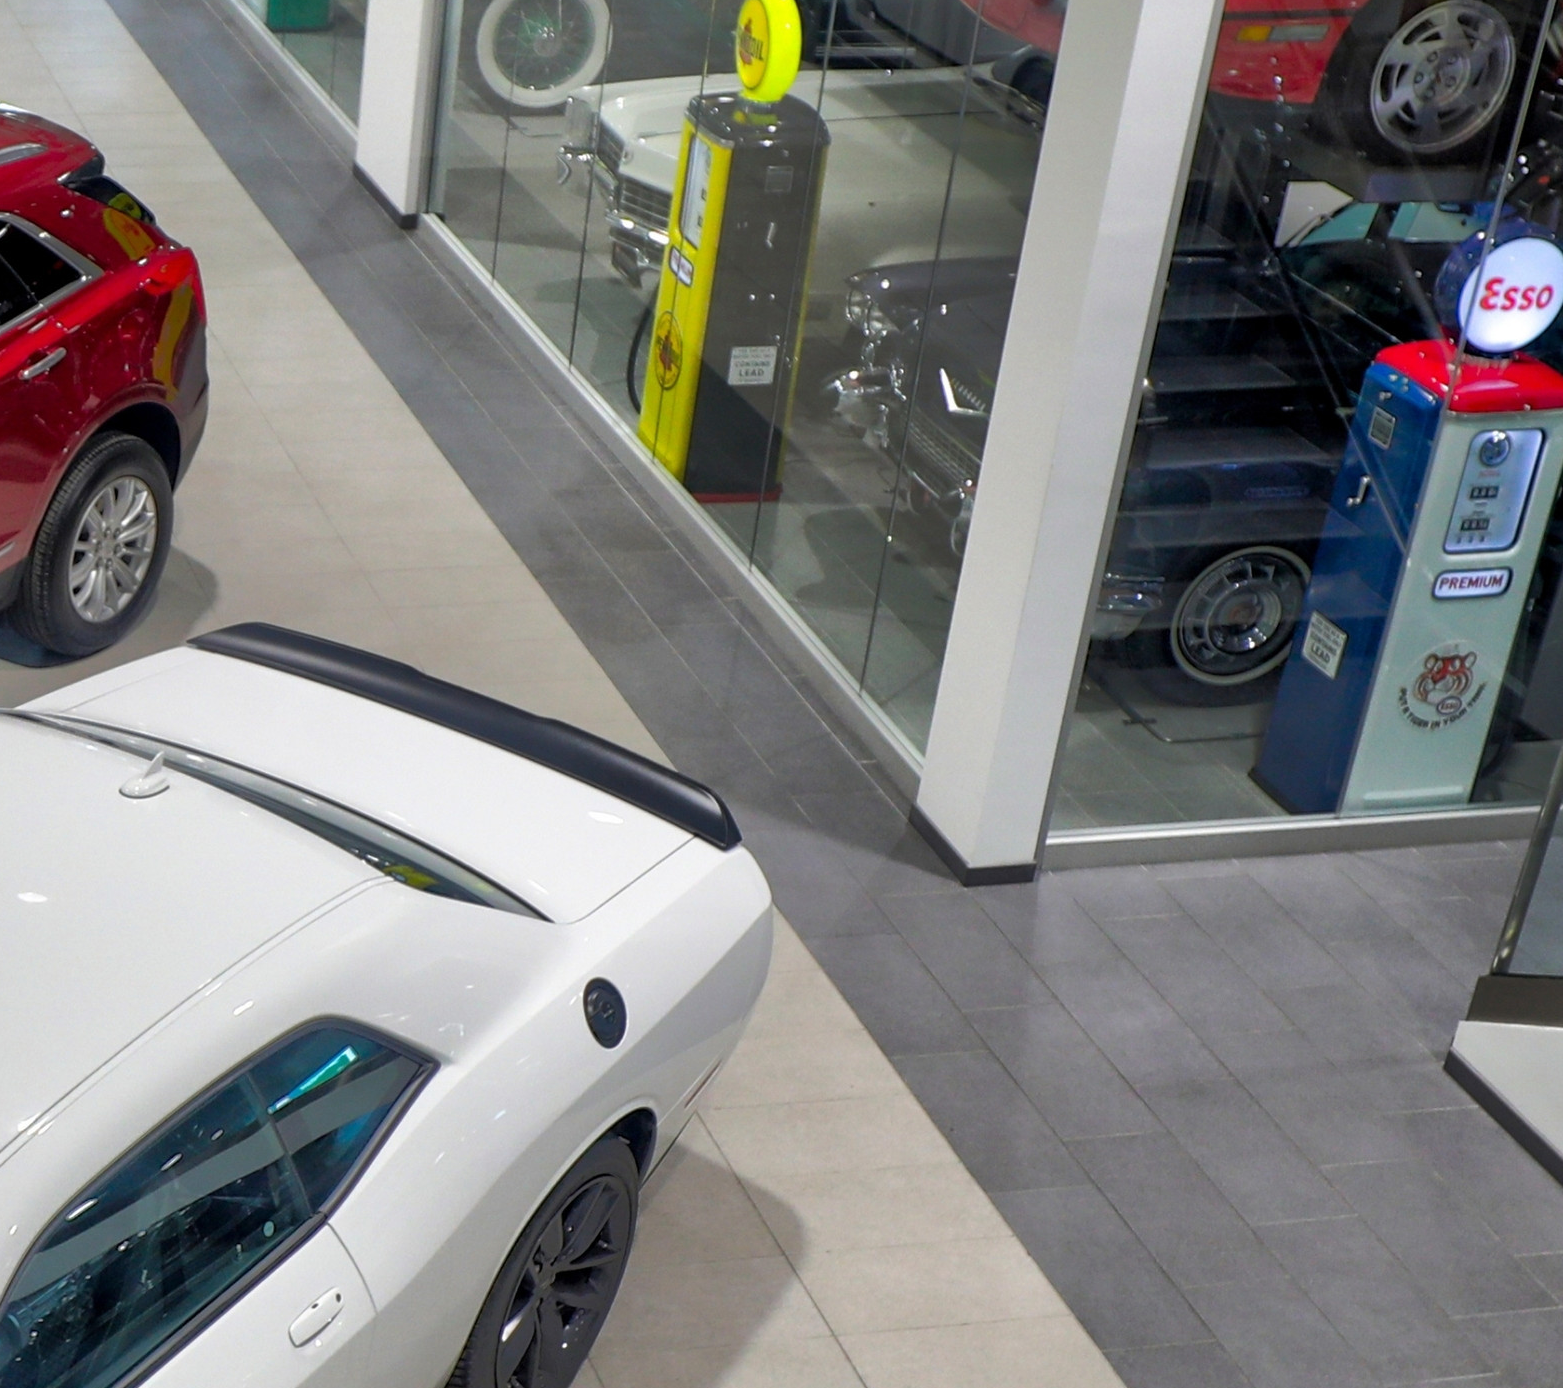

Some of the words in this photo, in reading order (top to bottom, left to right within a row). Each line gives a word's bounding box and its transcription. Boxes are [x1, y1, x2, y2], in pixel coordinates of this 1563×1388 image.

[738, 368, 764, 376] LEAD
[1439, 573, 1504, 590] PREMIUM
[1310, 641, 1331, 664] LEAD
[1442, 707, 1468, 726] YOUR
